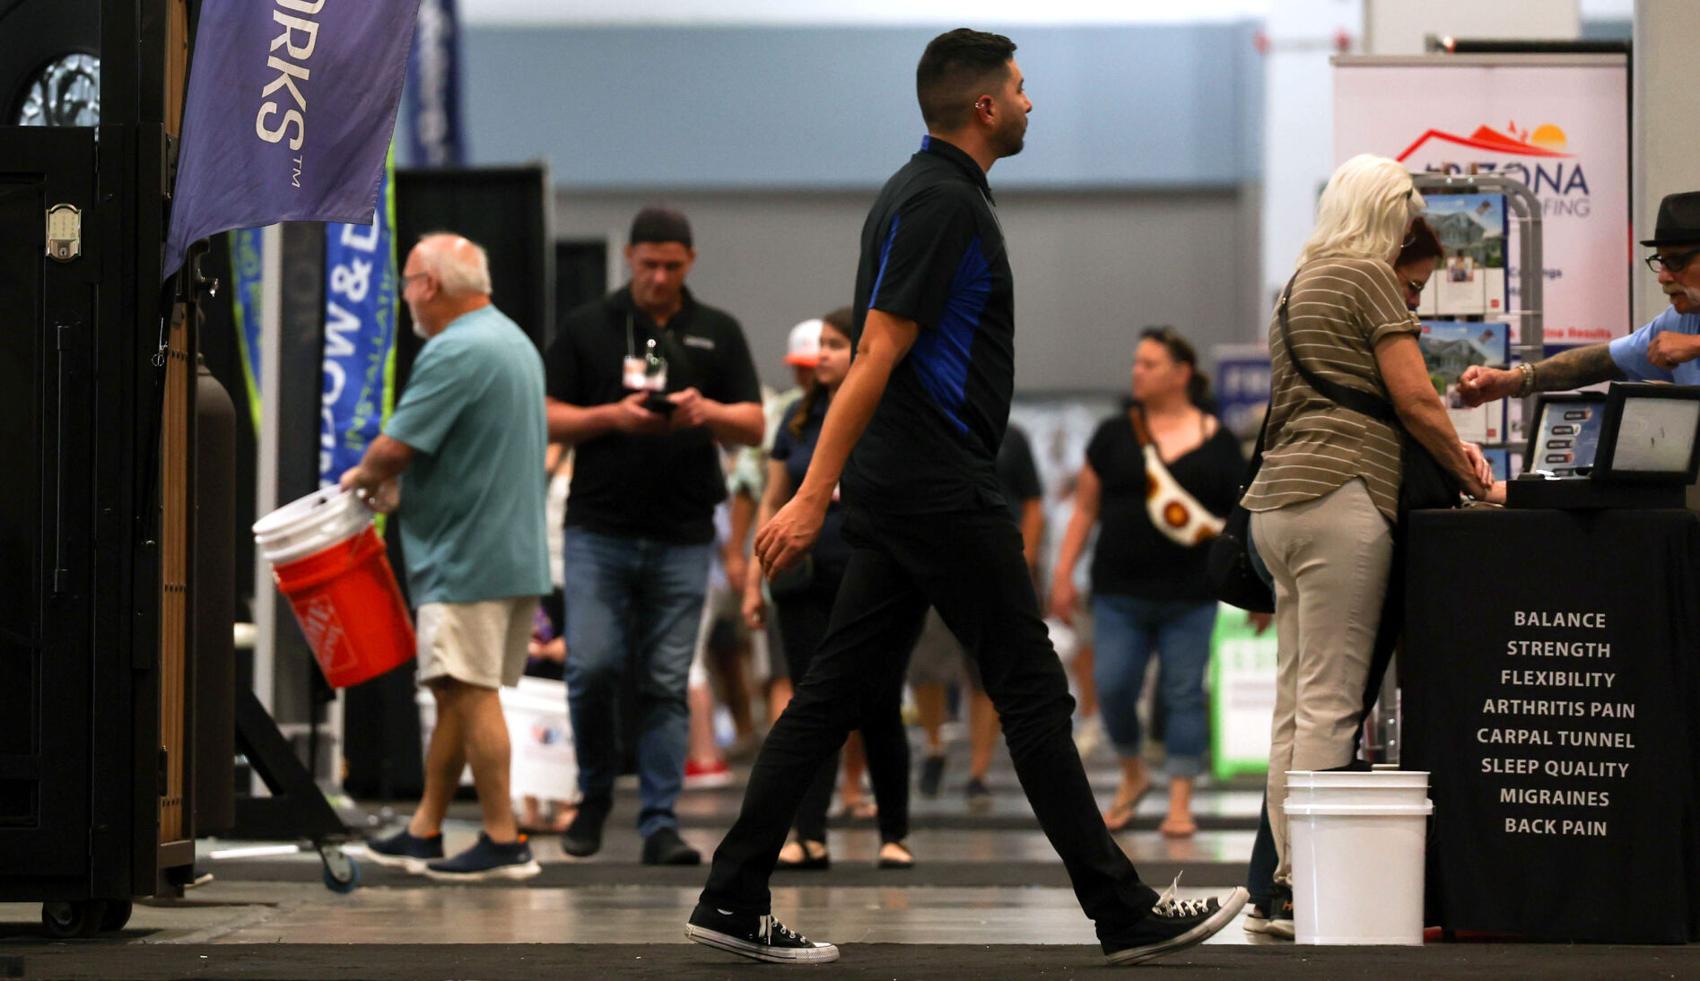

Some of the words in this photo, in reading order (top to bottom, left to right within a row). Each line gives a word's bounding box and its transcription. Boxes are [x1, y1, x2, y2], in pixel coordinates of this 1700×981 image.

[341, 208, 380, 252] D
[330, 256, 374, 304] &
[1514, 611, 1606, 628] BALANCE
[1507, 640, 1611, 658] STRENGTH
[1501, 670, 1616, 688] FLEXIBILITY
[1482, 698, 1585, 717] ARTHRITIS
[1590, 702, 1635, 718] PAIN
[1476, 728, 1553, 745] CARPAL
[1557, 731, 1635, 748] TUNNEL
[1481, 757, 1539, 774] SLEEP
[1544, 760, 1629, 778] QUALITY
[1500, 788, 1610, 807] MIGRAINES
[1505, 817, 1557, 834] BACK
[1562, 820, 1607, 836] PAIN
